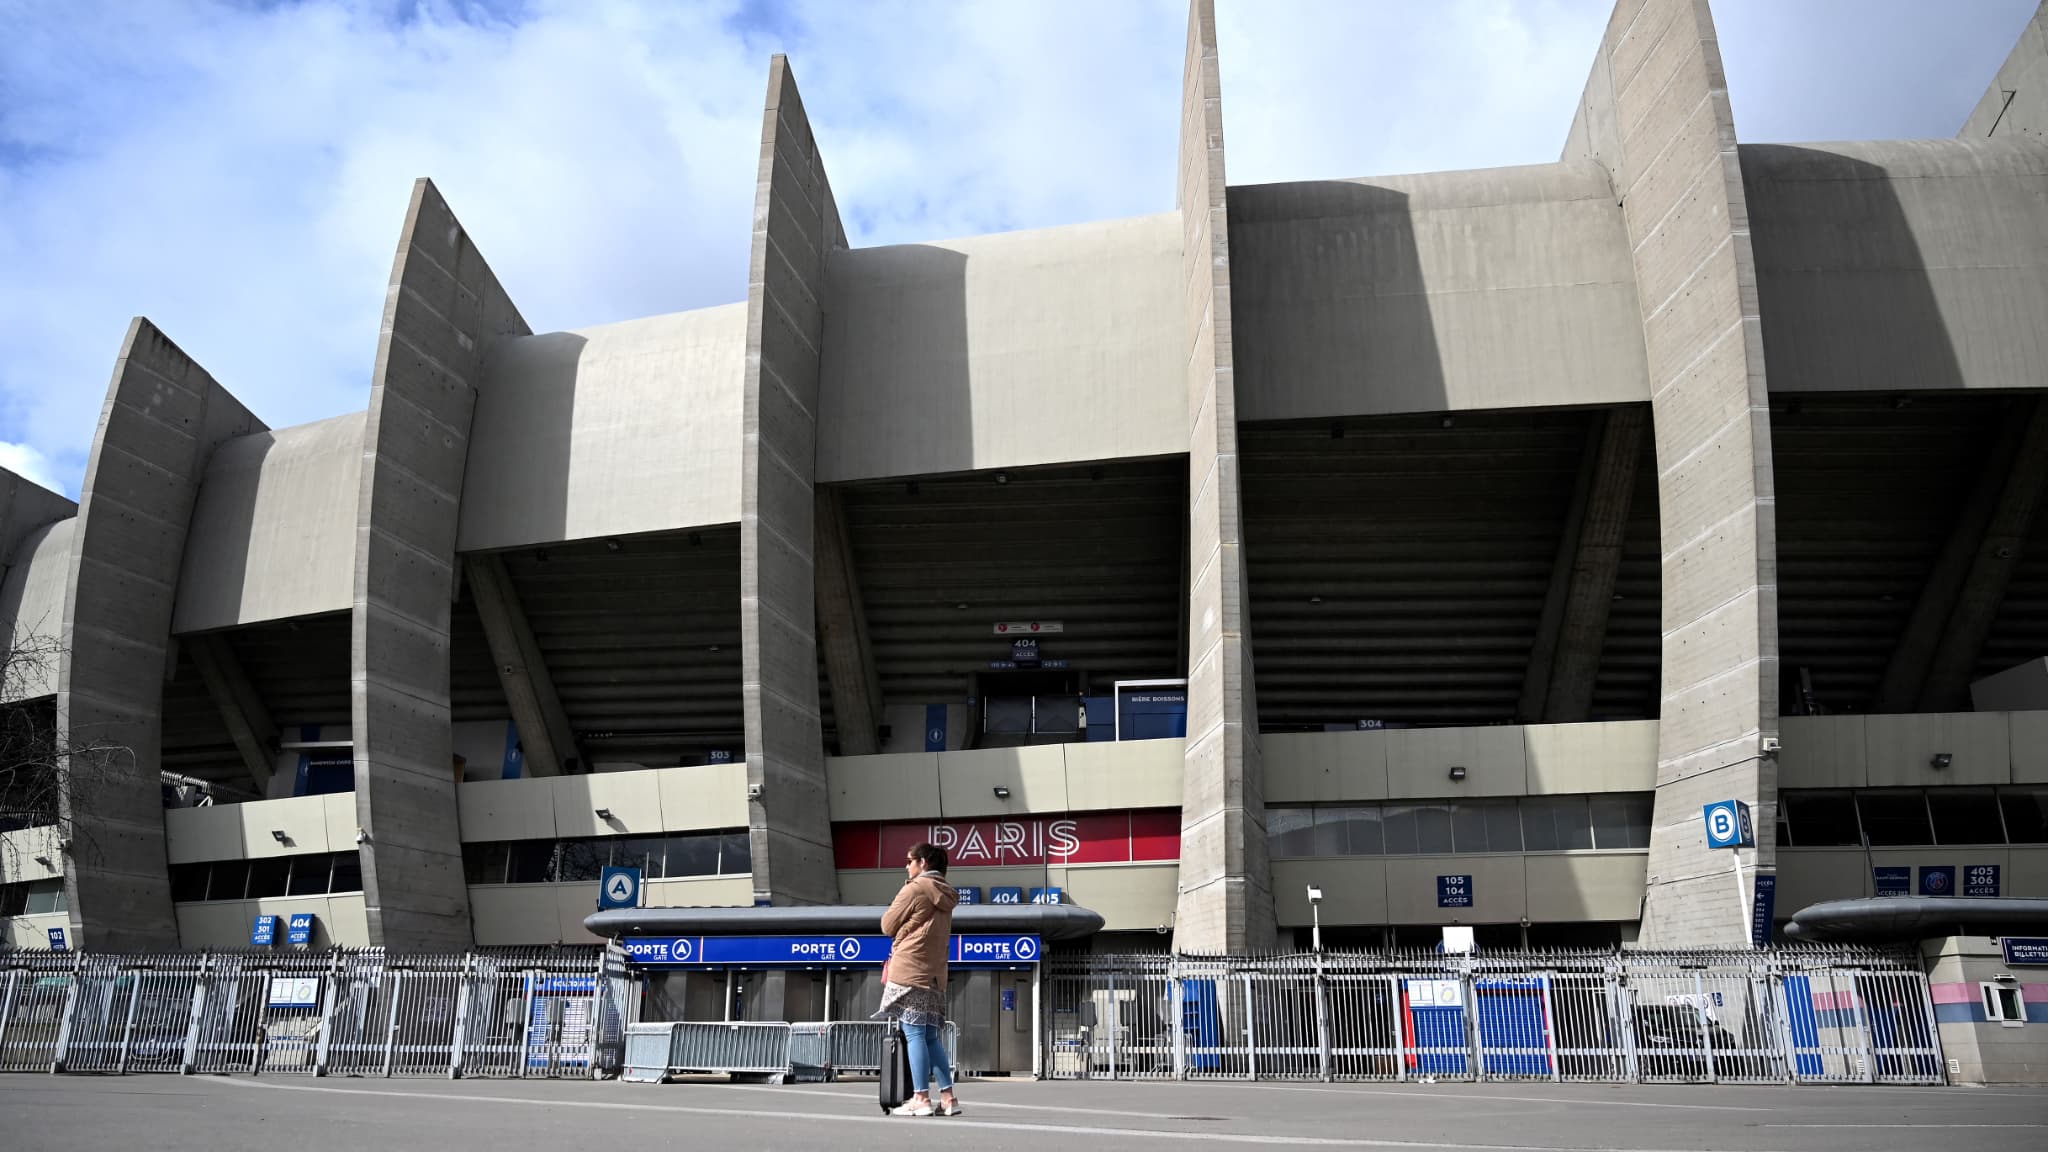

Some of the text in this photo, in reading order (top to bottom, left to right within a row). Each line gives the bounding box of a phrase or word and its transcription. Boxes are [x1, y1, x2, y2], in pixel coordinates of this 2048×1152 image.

[1014, 639, 1036, 647] 404
[1360, 719, 1383, 728] 304
[1714, 814, 1730, 834] B
[1741, 814, 1750, 834] B
[927, 820, 1081, 860] PARIS
[1970, 867, 1994, 876] 405
[1445, 876, 1464, 885] 105
[1970, 876, 1994, 885] 306
[611, 879, 628, 895] A
[1445, 887, 1465, 895] 104
[992, 893, 1018, 904] 404
[1032, 893, 1059, 904] 405
[258, 916, 272, 924] 302
[291, 918, 310, 928] 404
[50, 931, 63, 940] 102
[626, 944, 668, 955] PORTE
[791, 943, 836, 954] PORTE
[964, 942, 1010, 953] PORTE
